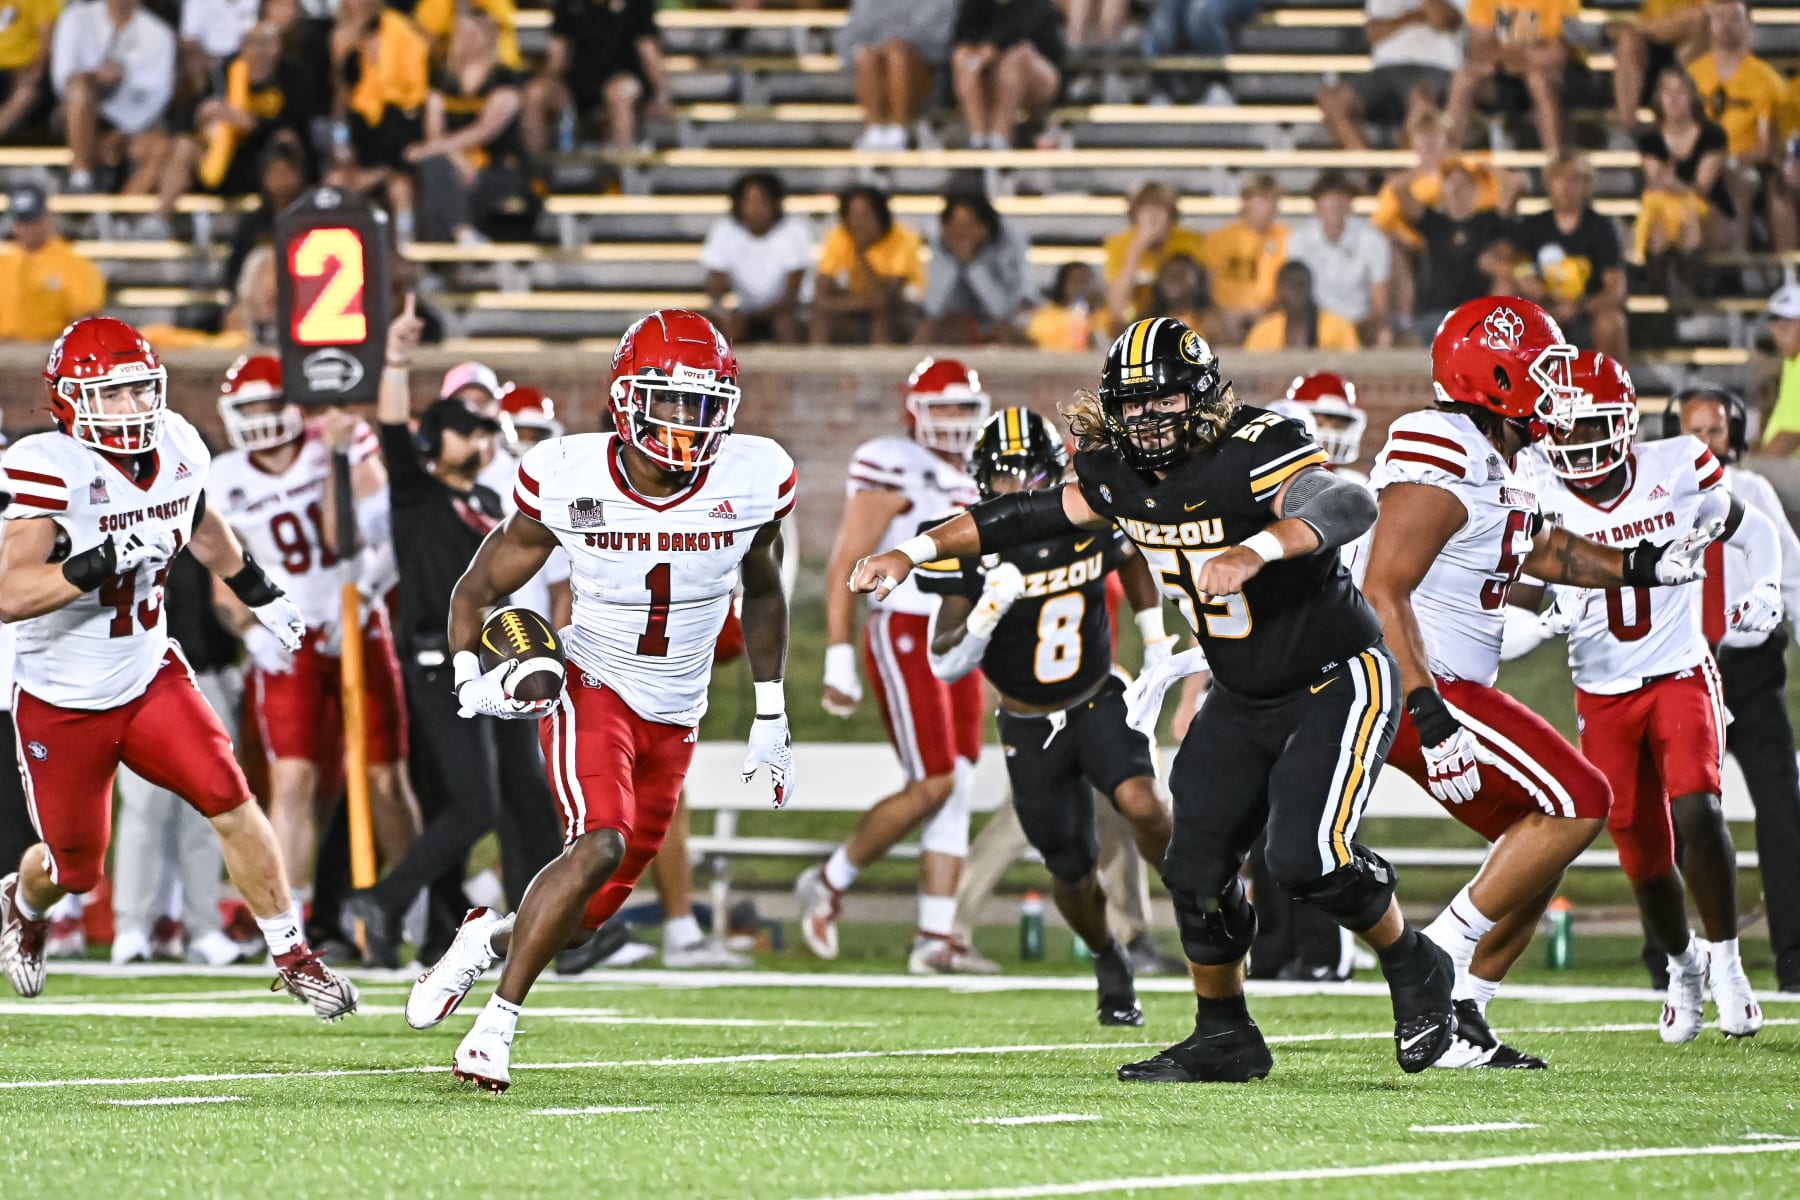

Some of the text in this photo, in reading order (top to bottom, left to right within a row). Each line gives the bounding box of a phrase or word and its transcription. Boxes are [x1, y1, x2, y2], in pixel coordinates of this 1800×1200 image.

[292, 228, 367, 343] 2
[120, 364, 145, 373] VOTES
[683, 370, 705, 380] VOTES
[99, 509, 144, 532] SOUTH
[708, 511, 737, 520] adidas
[1611, 511, 1676, 543] DAKOTA
[584, 531, 734, 551] SOUTH DAKOTA
[1114, 516, 1225, 546] MIZZOU
[1016, 552, 1104, 598] ZZOU
[1136, 545, 1253, 639] 55
[636, 562, 671, 657] 1
[1033, 591, 1086, 684] 8
[1321, 661, 1339, 673] 2XL
